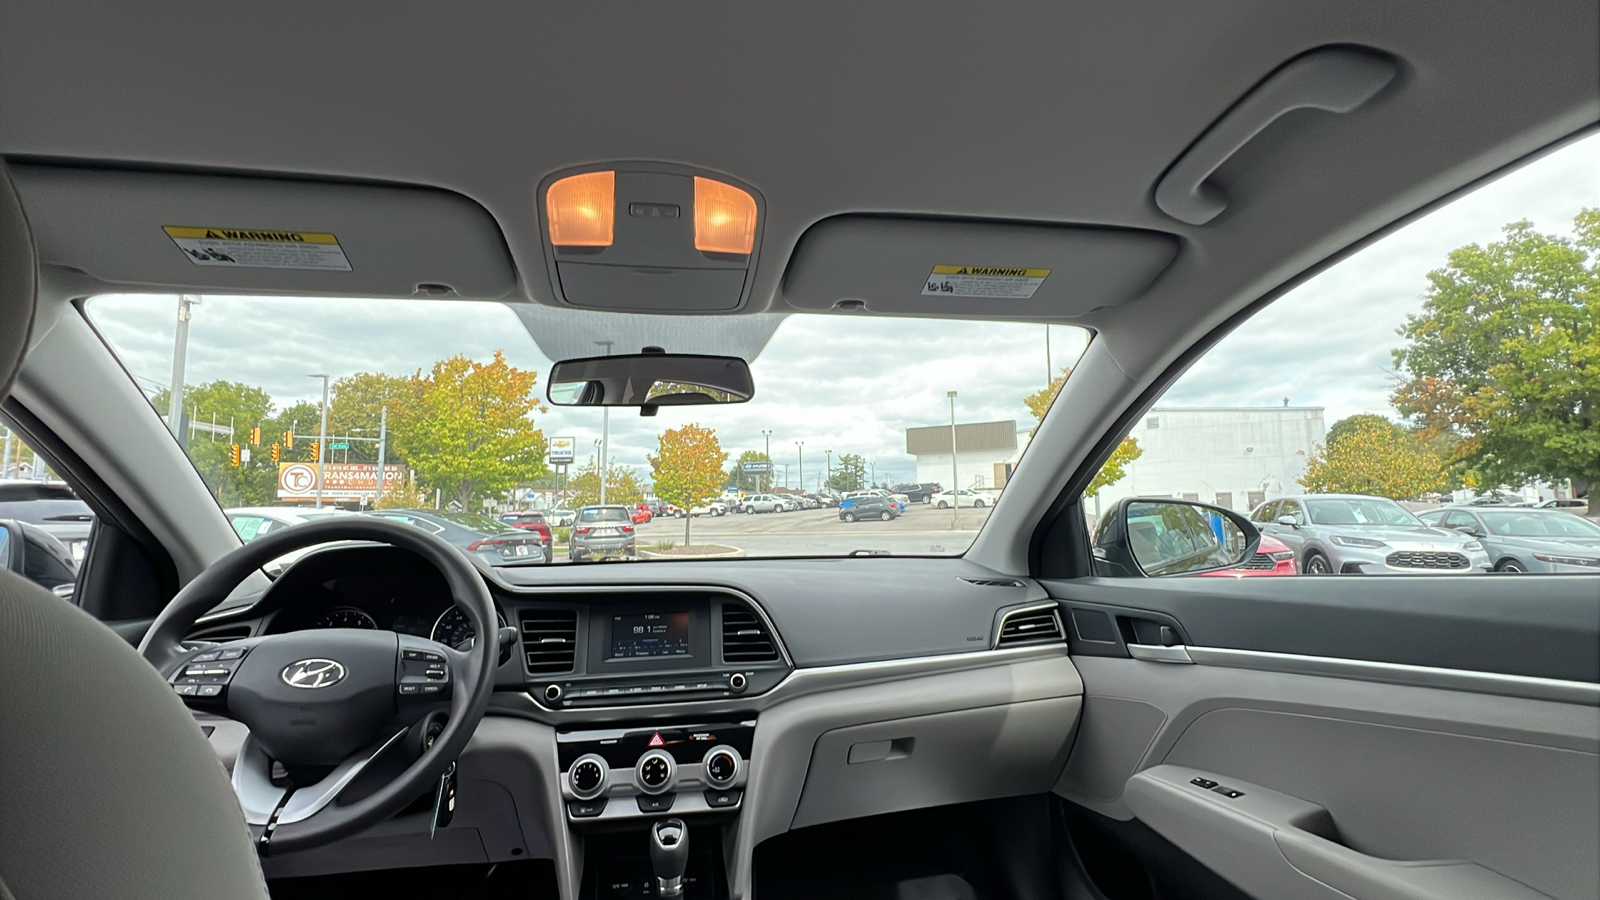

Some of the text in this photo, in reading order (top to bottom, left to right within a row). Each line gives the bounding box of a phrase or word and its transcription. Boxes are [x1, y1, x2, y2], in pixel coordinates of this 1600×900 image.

[221, 230, 304, 242] WARNING
[971, 267, 1028, 277] WARNING
[289, 472, 309, 488] TC
[322, 471, 403, 481] RANS4MAION
